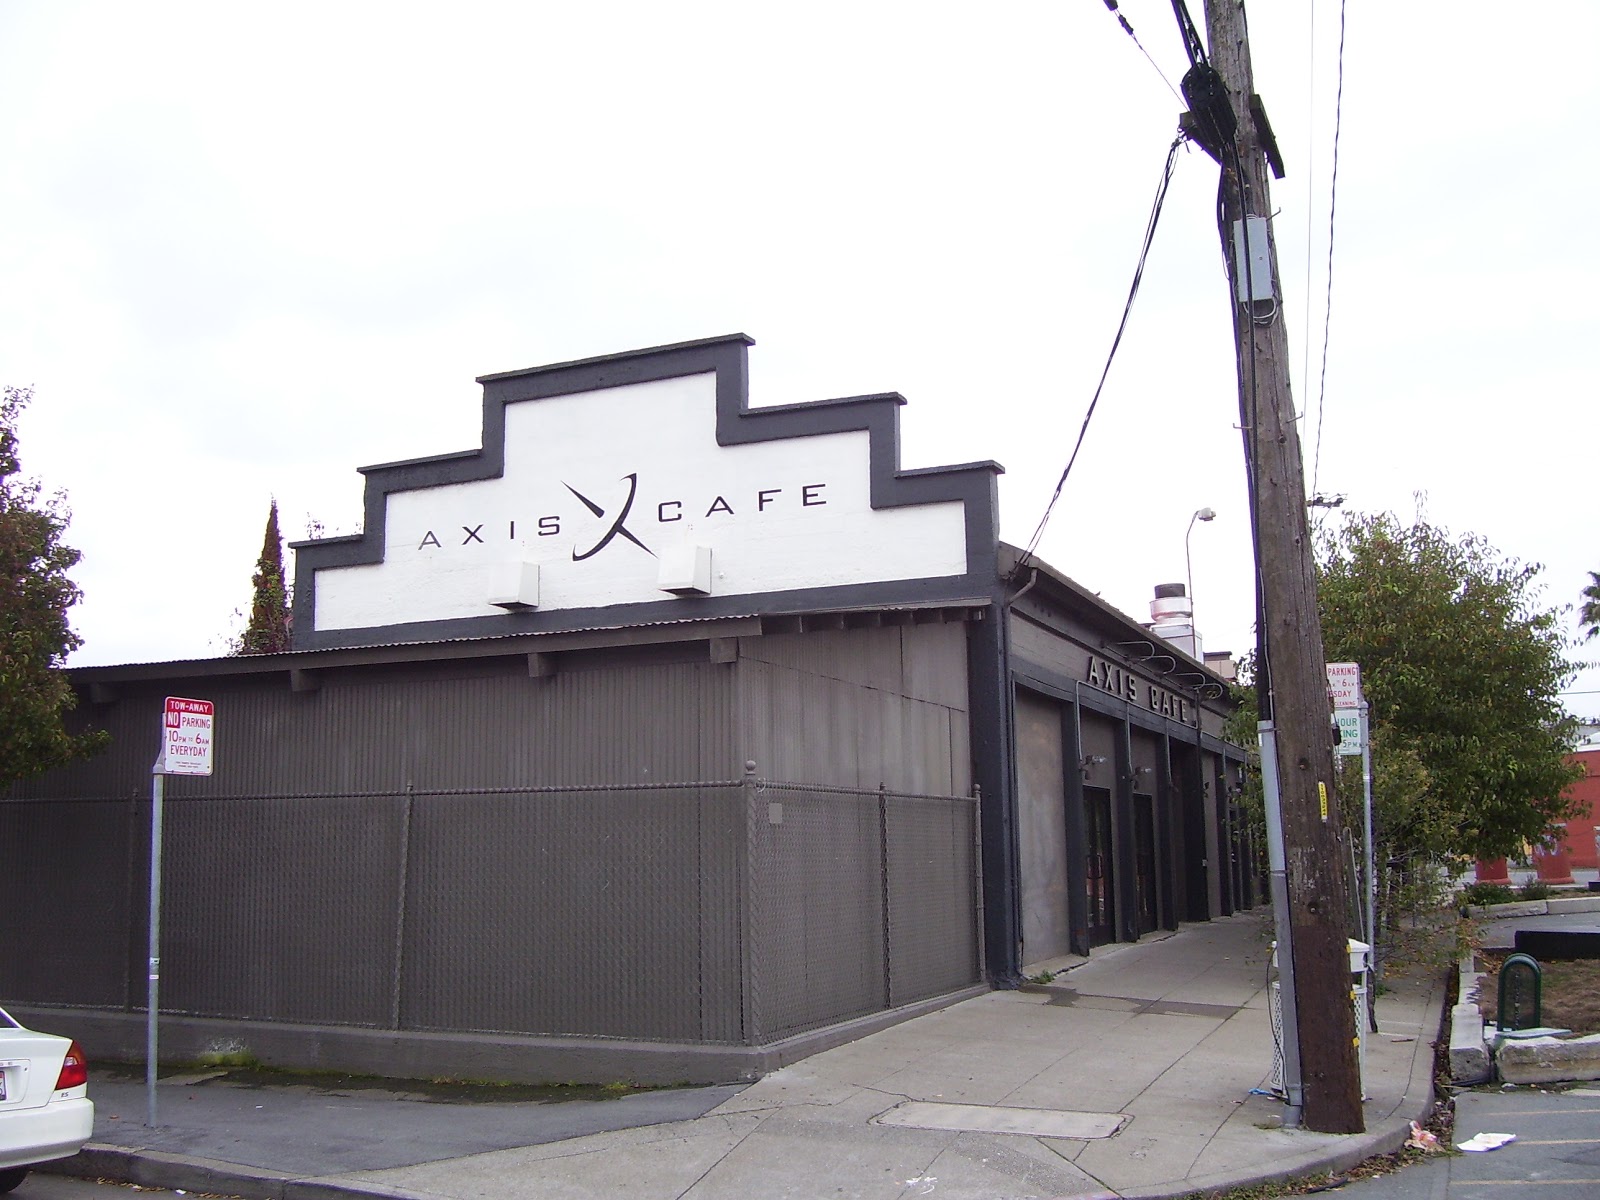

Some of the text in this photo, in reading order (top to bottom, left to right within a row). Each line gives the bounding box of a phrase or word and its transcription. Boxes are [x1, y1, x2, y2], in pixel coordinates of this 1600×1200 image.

[418, 516, 560, 550] AXIS
[658, 483, 827, 523] CAFE
[1328, 667, 1356, 676] PARKING
[1088, 656, 1188, 721] AXIS CAFE
[170, 701, 209, 713] TOW-AWAY
[167, 711, 210, 728] NO PARKING
[171, 745, 207, 757] EVERYDAY
